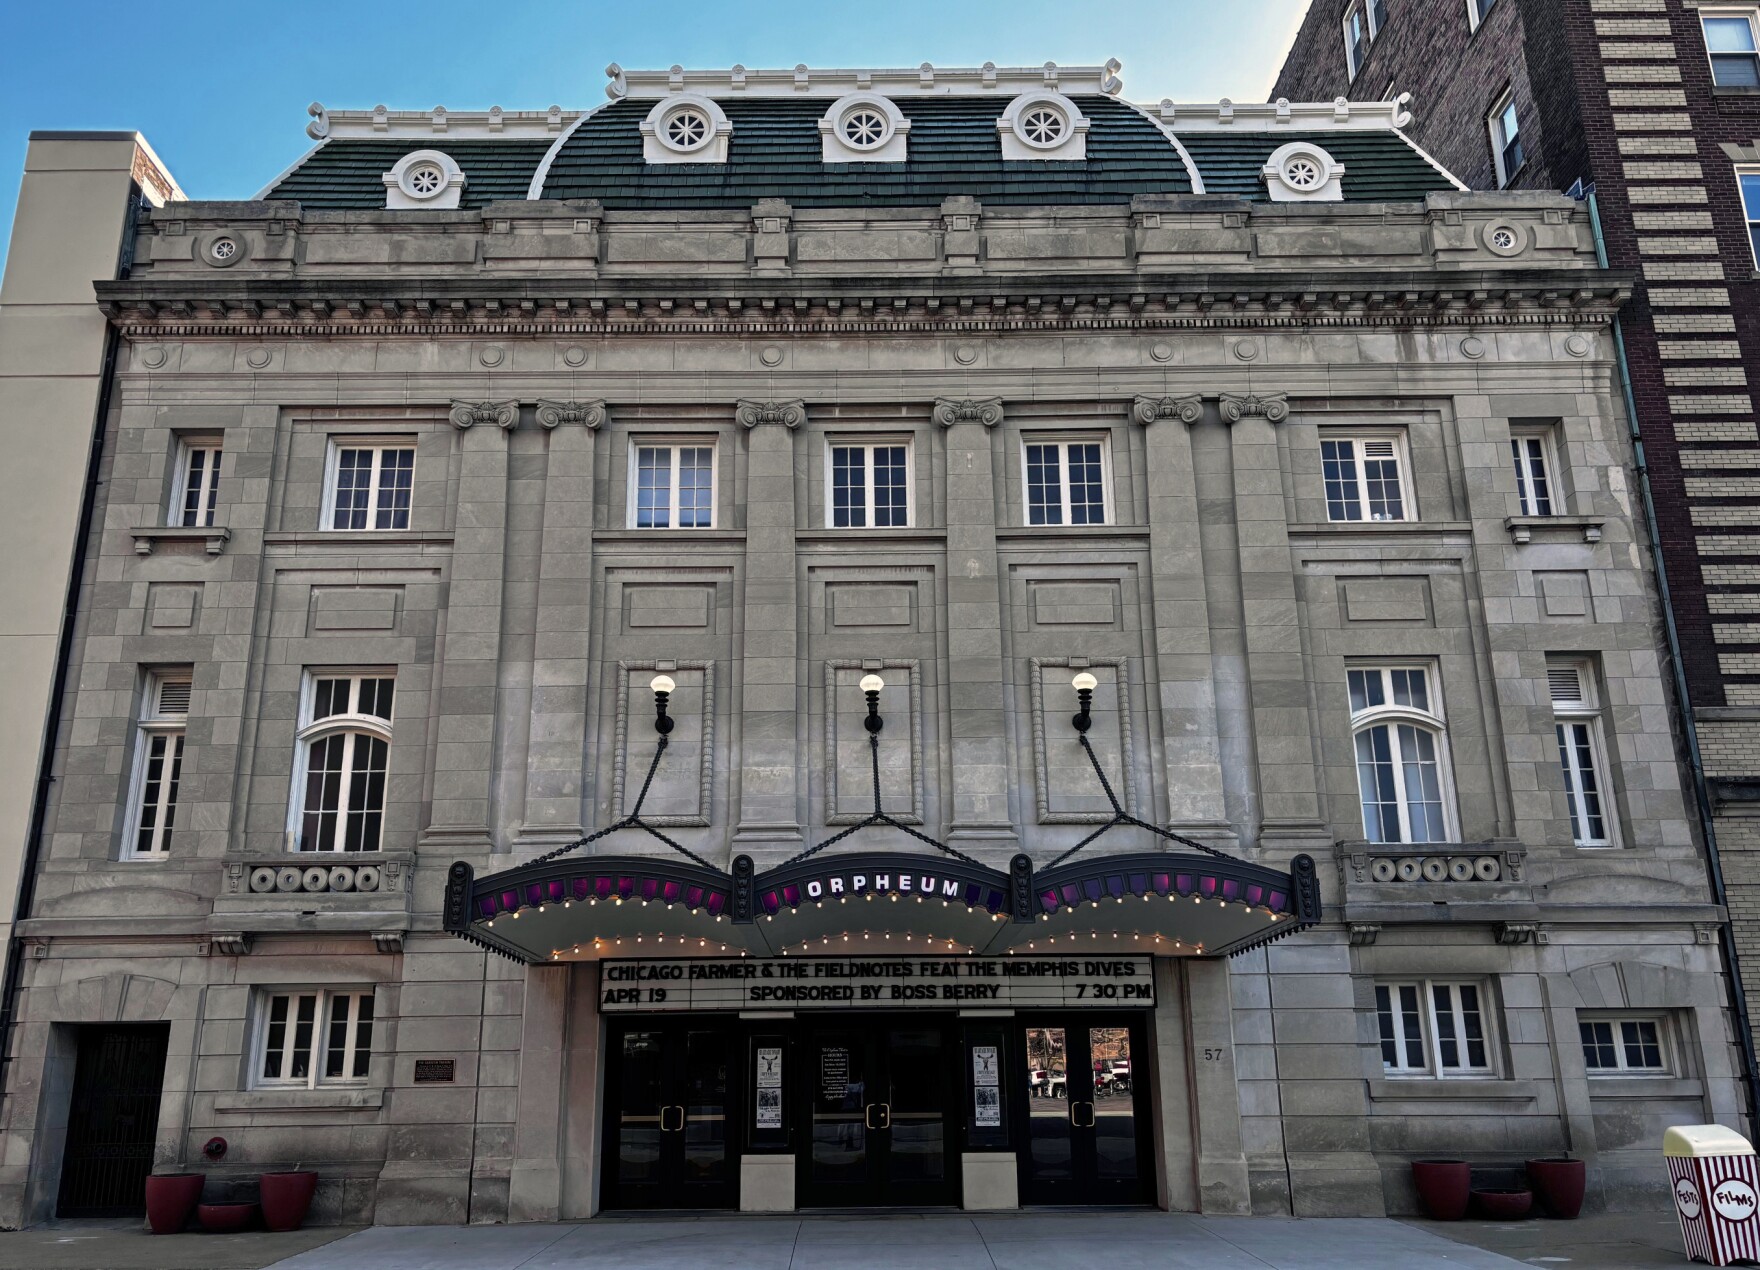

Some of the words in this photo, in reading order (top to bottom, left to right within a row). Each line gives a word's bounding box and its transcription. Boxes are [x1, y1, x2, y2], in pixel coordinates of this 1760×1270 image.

[807, 874, 959, 897] ORPHEUM
[607, 964, 683, 981] CHICAGO
[688, 963, 757, 980] FARMER
[761, 963, 774, 978] &
[777, 963, 809, 979] THE
[814, 962, 913, 979] FIELDNOTES
[920, 962, 960, 977] FEAT
[965, 961, 997, 977] THE
[1002, 961, 1079, 977] MEMPHIS
[1084, 961, 1136, 976] DIVES
[603, 988, 640, 1004] APR
[648, 988, 667, 1002] 19
[750, 985, 854, 1001] SPONSORED
[861, 984, 882, 1000] BY
[890, 984, 937, 1000] BOSS
[942, 984, 1001, 1000] BERRY
[1123, 984, 1151, 999] PM
[1204, 1048, 1223, 1061] 57
[1677, 1190, 1699, 1206] FESTS
[1716, 1190, 1754, 1208] FILMS
